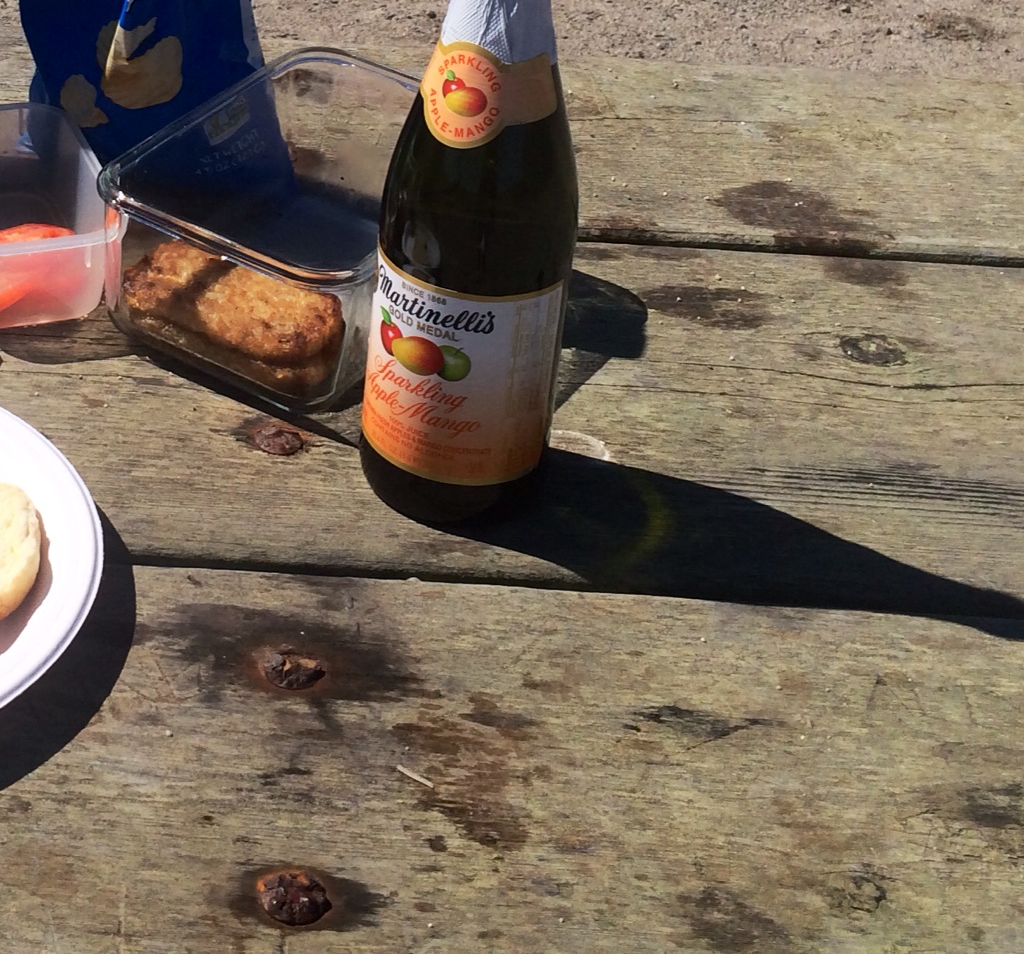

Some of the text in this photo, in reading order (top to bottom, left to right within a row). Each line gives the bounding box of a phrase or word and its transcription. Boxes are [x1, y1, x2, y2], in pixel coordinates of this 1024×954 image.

[438, 54, 501, 93] SPARKLING
[429, 88, 500, 138] APPLE-MANGO
[379, 264, 496, 335] Martinelli's
[401, 281, 447, 306] SINCE 1868
[389, 305, 460, 342] GOLD MEDAL
[374, 355, 467, 411] Sparkling
[366, 370, 481, 439] Apple-Mango
[401, 440, 413, 450] NO
[406, 425, 430, 439] JUICE
